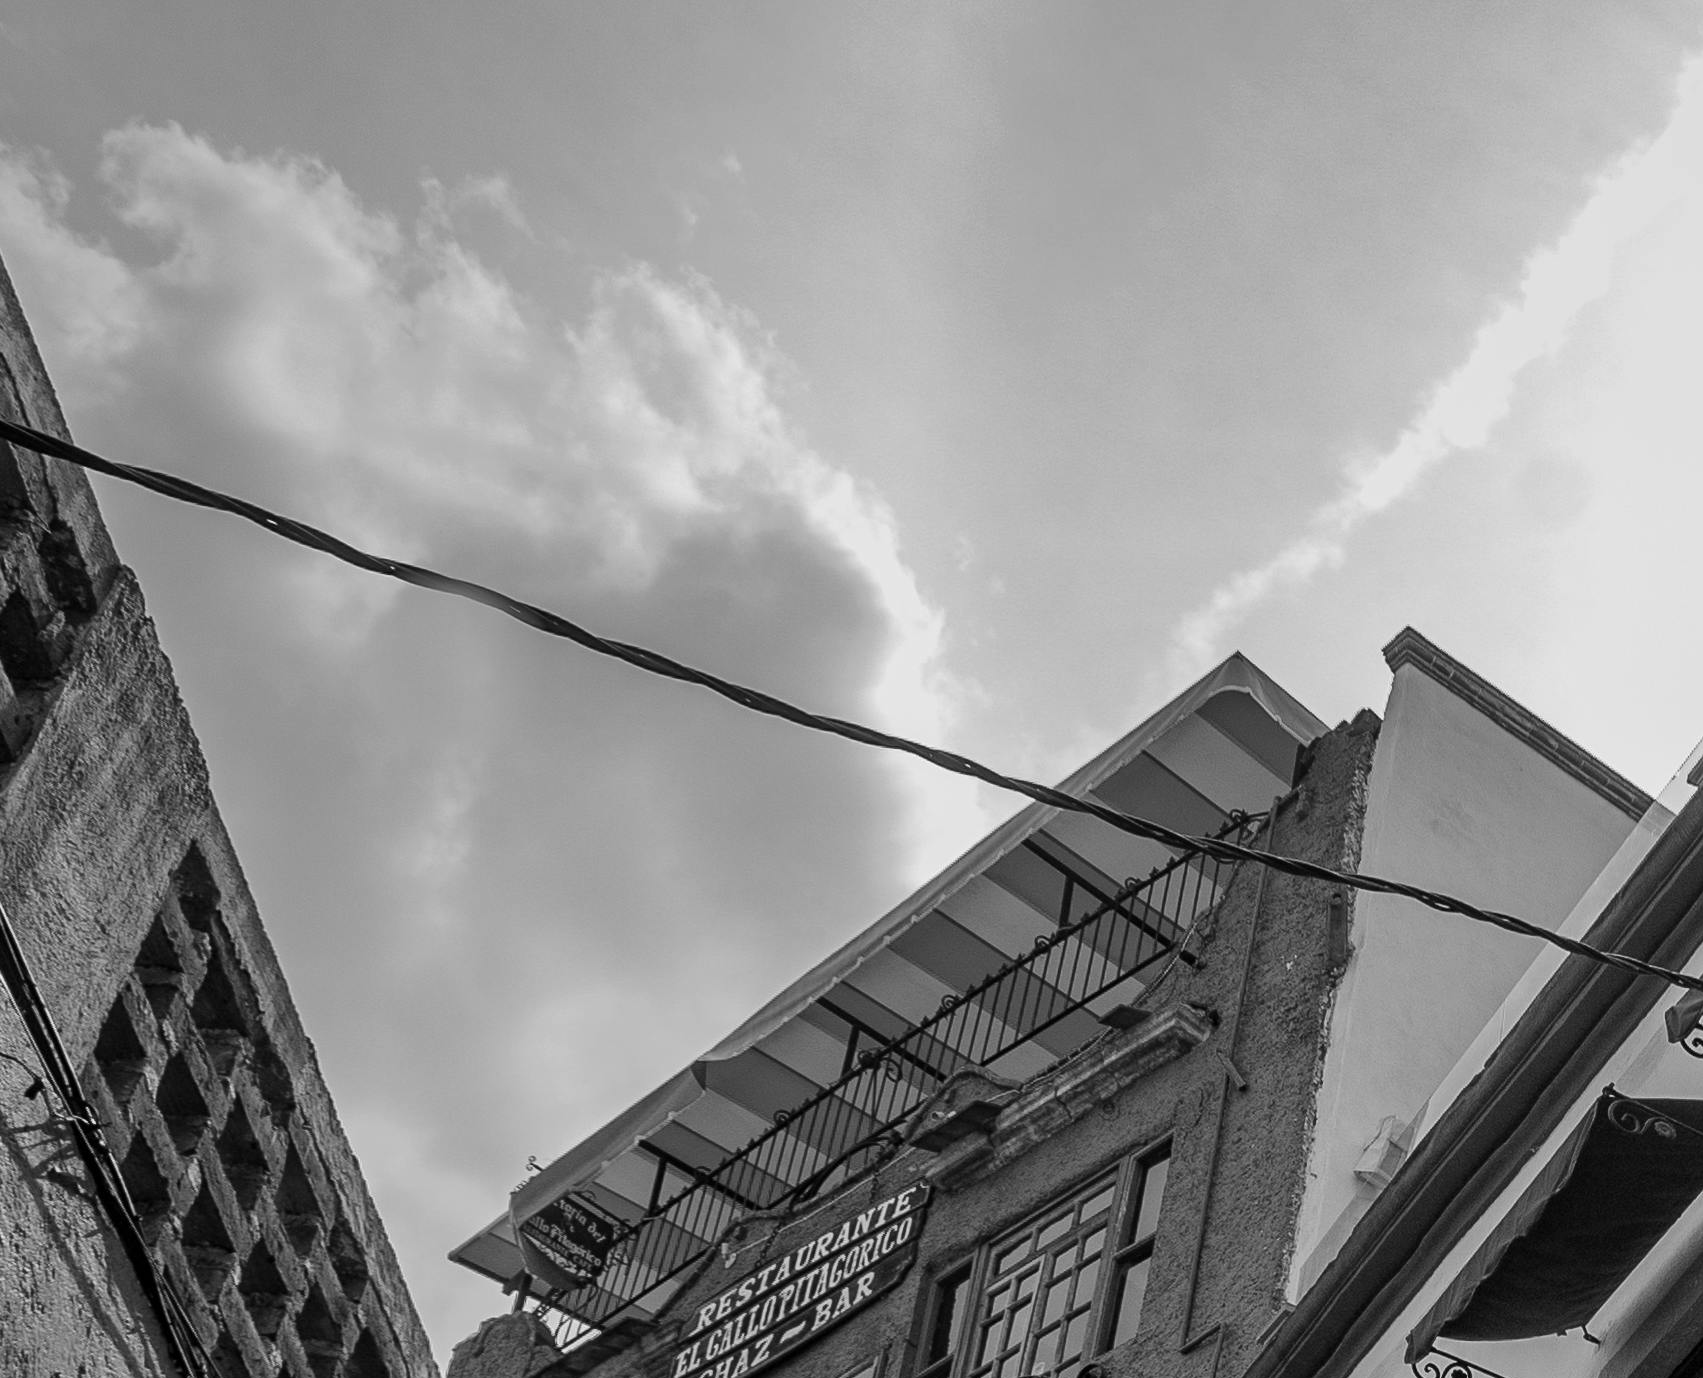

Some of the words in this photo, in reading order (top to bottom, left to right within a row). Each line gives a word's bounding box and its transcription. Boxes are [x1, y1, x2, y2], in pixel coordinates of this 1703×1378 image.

[673, 1346, 701, 1378] EL
[705, 1294, 776, 1360] GALLO
[776, 1217, 913, 1321] PITAGORICO
[688, 1187, 917, 1337] RESTAURANTE
[811, 1271, 875, 1331] BAR
